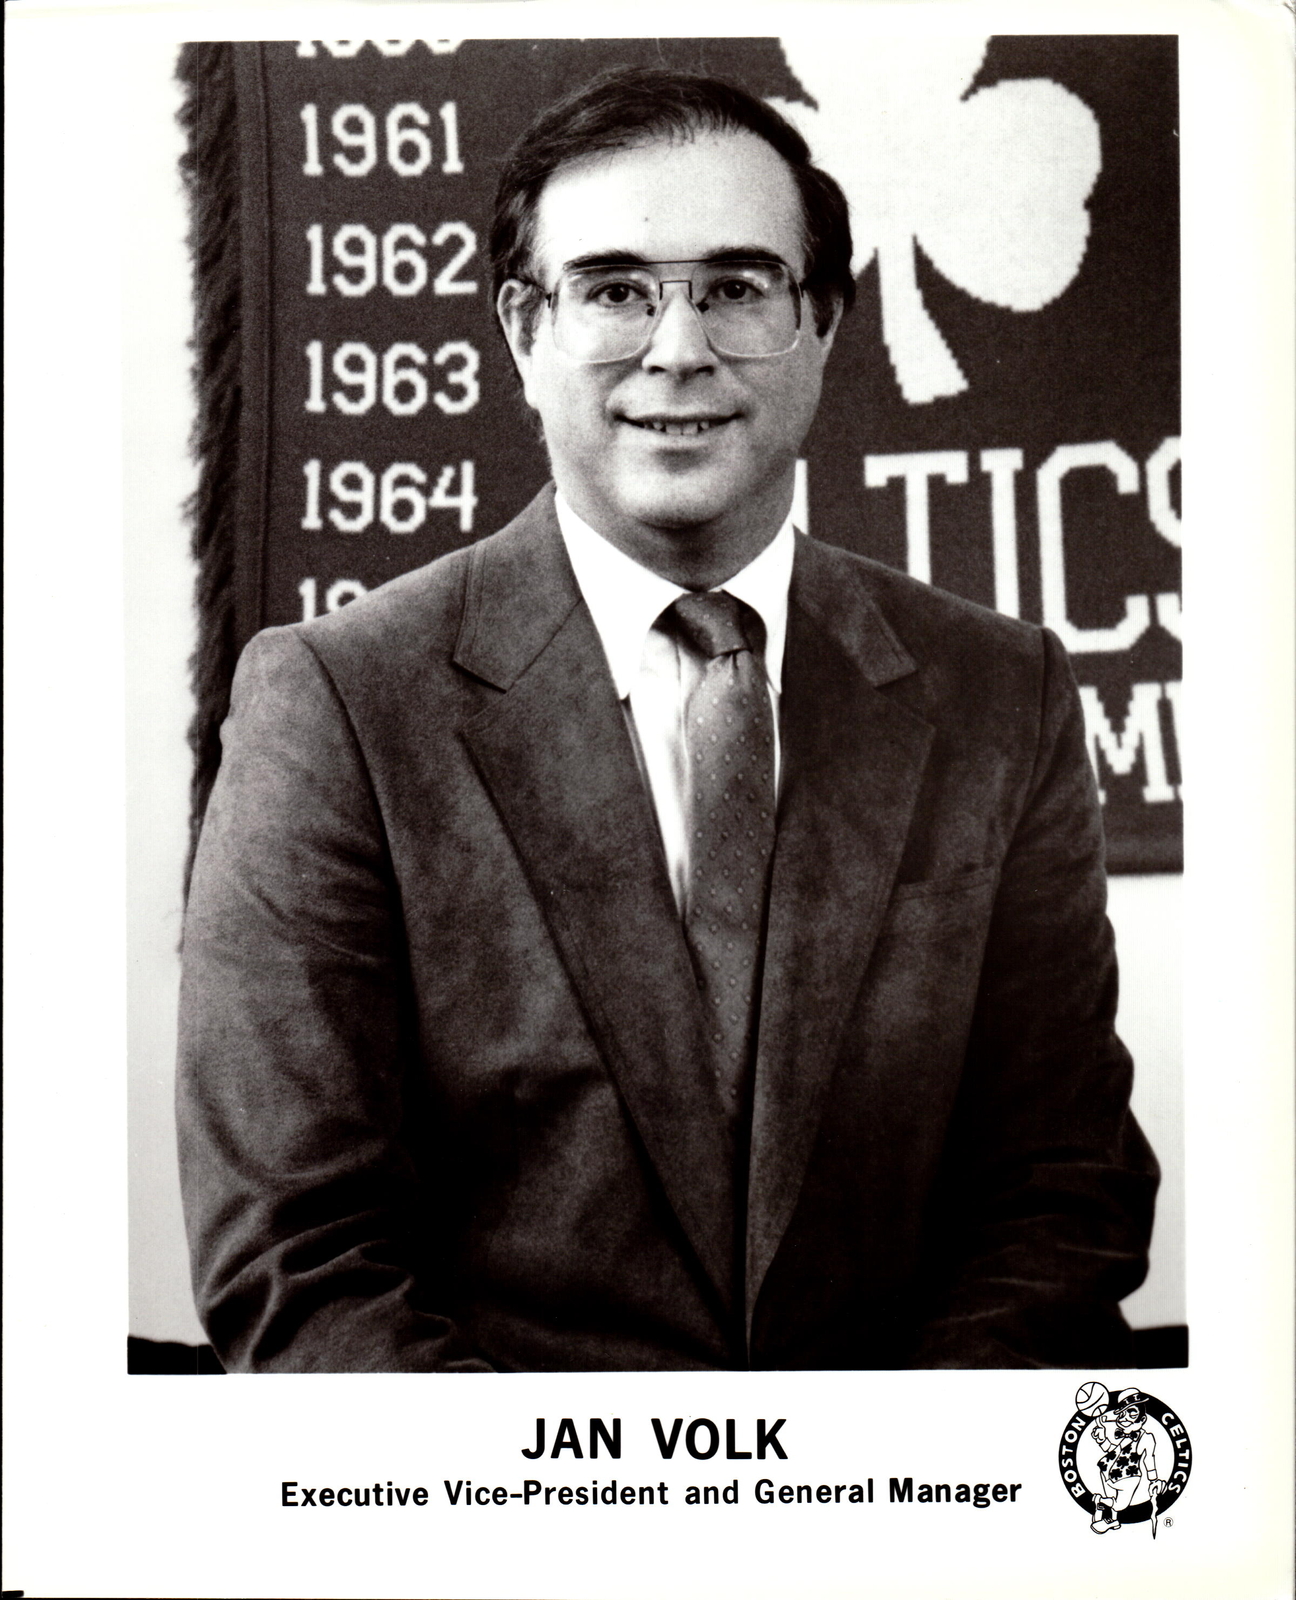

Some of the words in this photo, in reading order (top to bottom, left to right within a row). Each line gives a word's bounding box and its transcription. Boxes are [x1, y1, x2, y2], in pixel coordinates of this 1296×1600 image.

[301, 102, 465, 178] 1961
[306, 222, 479, 298] 1962
[306, 341, 481, 417] 1963
[302, 459, 478, 534] 1964
